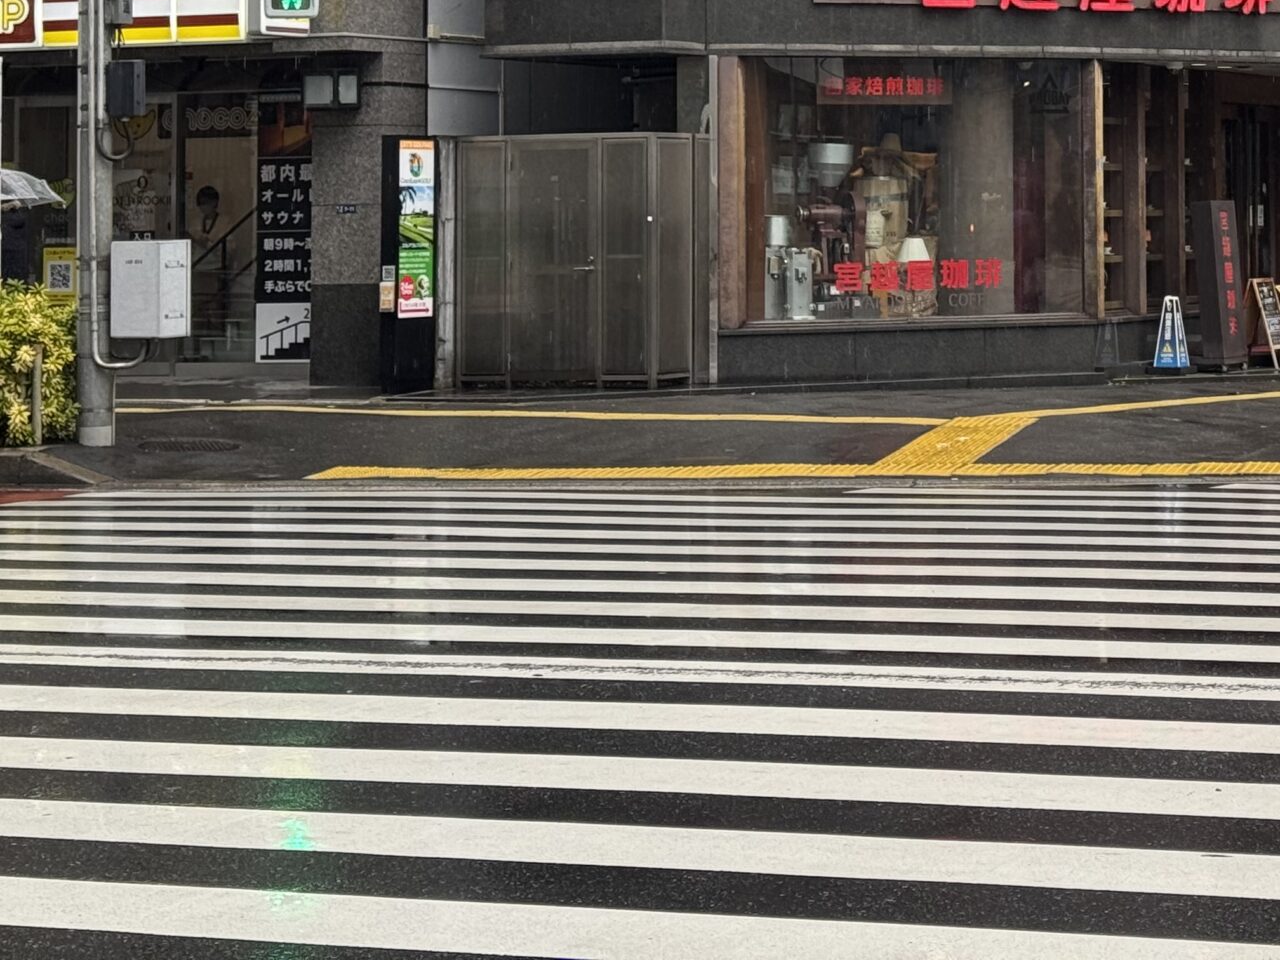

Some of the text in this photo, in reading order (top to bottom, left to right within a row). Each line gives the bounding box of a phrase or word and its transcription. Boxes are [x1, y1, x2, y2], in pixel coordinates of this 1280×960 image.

[261, 211, 304, 225] サウナ
[834, 257, 1003, 293] 宮越屋珈琲
